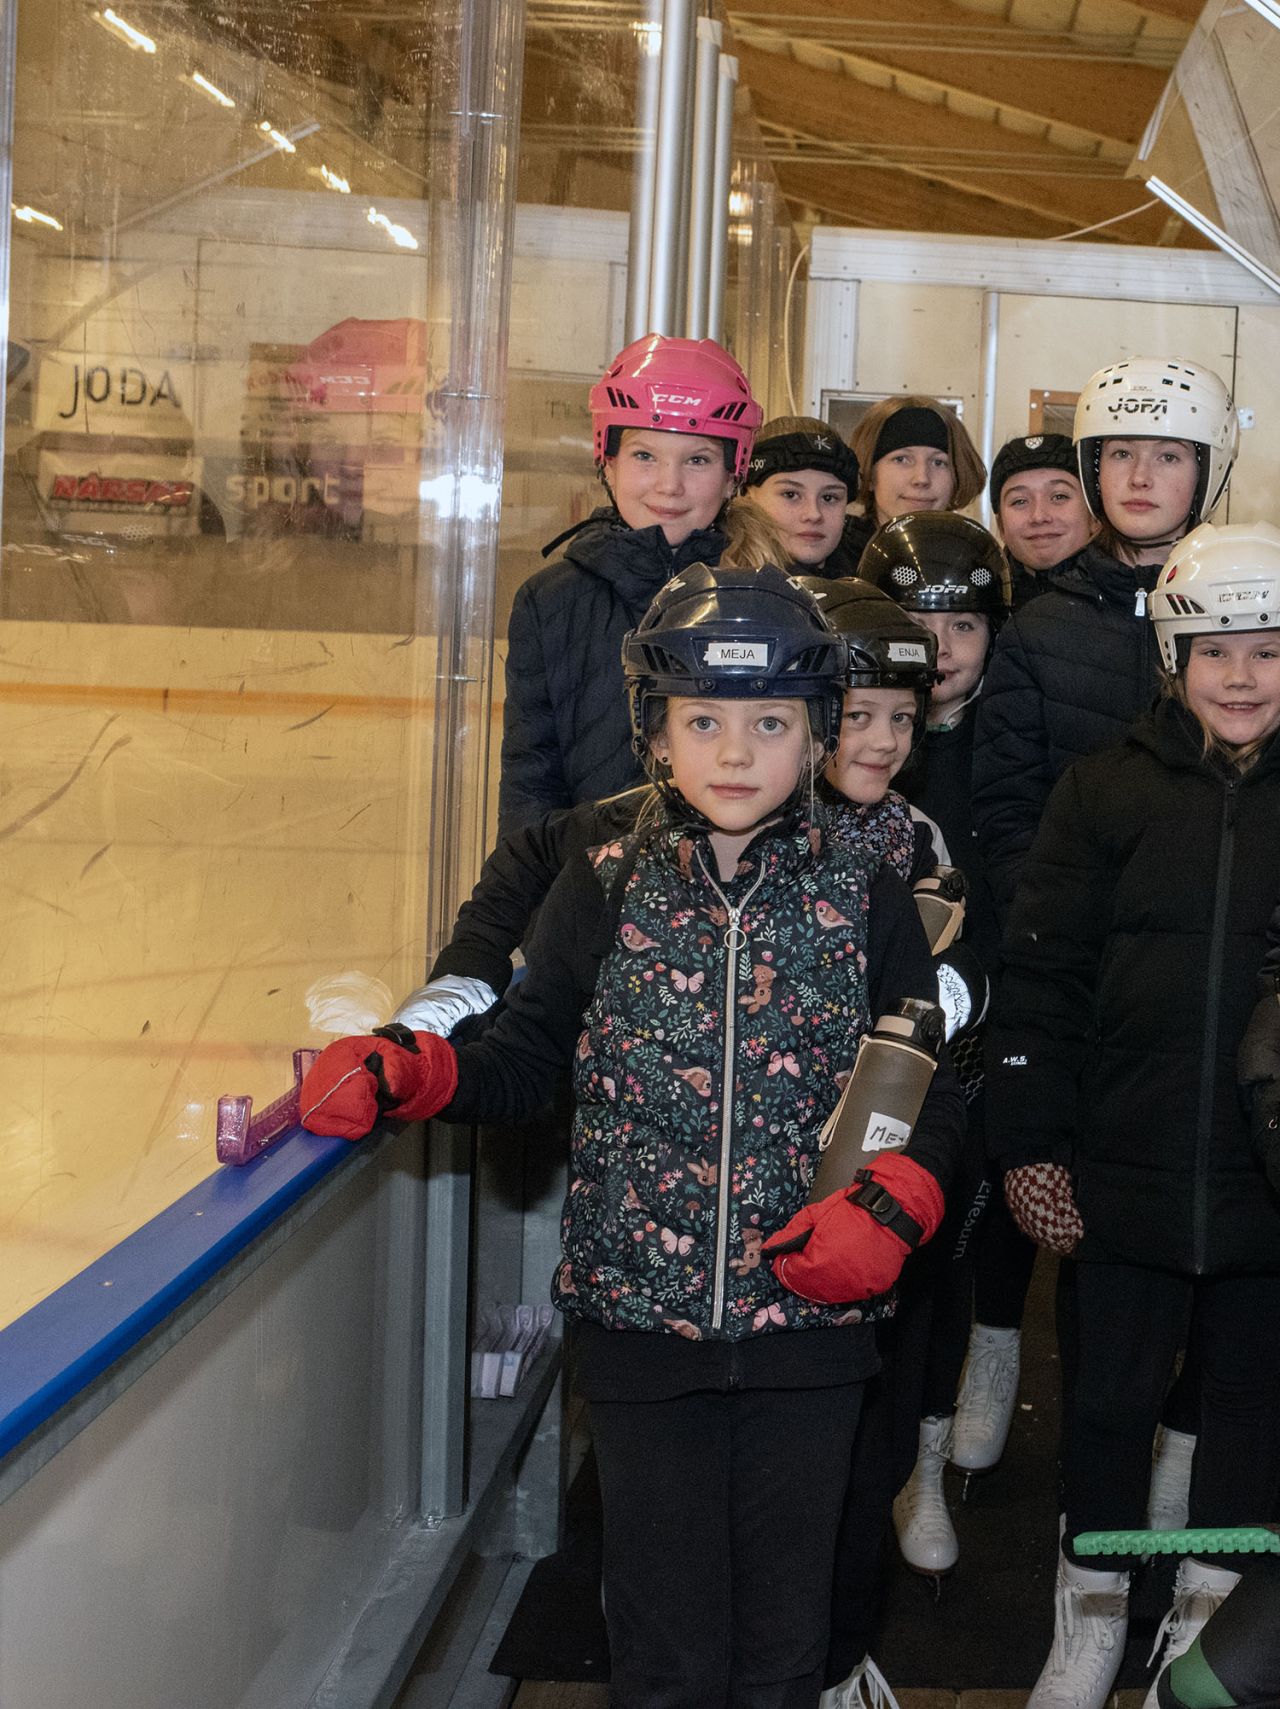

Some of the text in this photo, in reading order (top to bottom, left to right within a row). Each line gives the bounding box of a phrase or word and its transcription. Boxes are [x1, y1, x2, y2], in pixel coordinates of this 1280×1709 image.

[59, 365, 181, 419] JODA
[651, 393, 702, 406] CCM
[1108, 397, 1168, 414] JOFA
[226, 472, 341, 509] sport
[918, 584, 969, 594] JOFA
[720, 648, 755, 660] MEJA
[898, 647, 920, 657] ENJA
